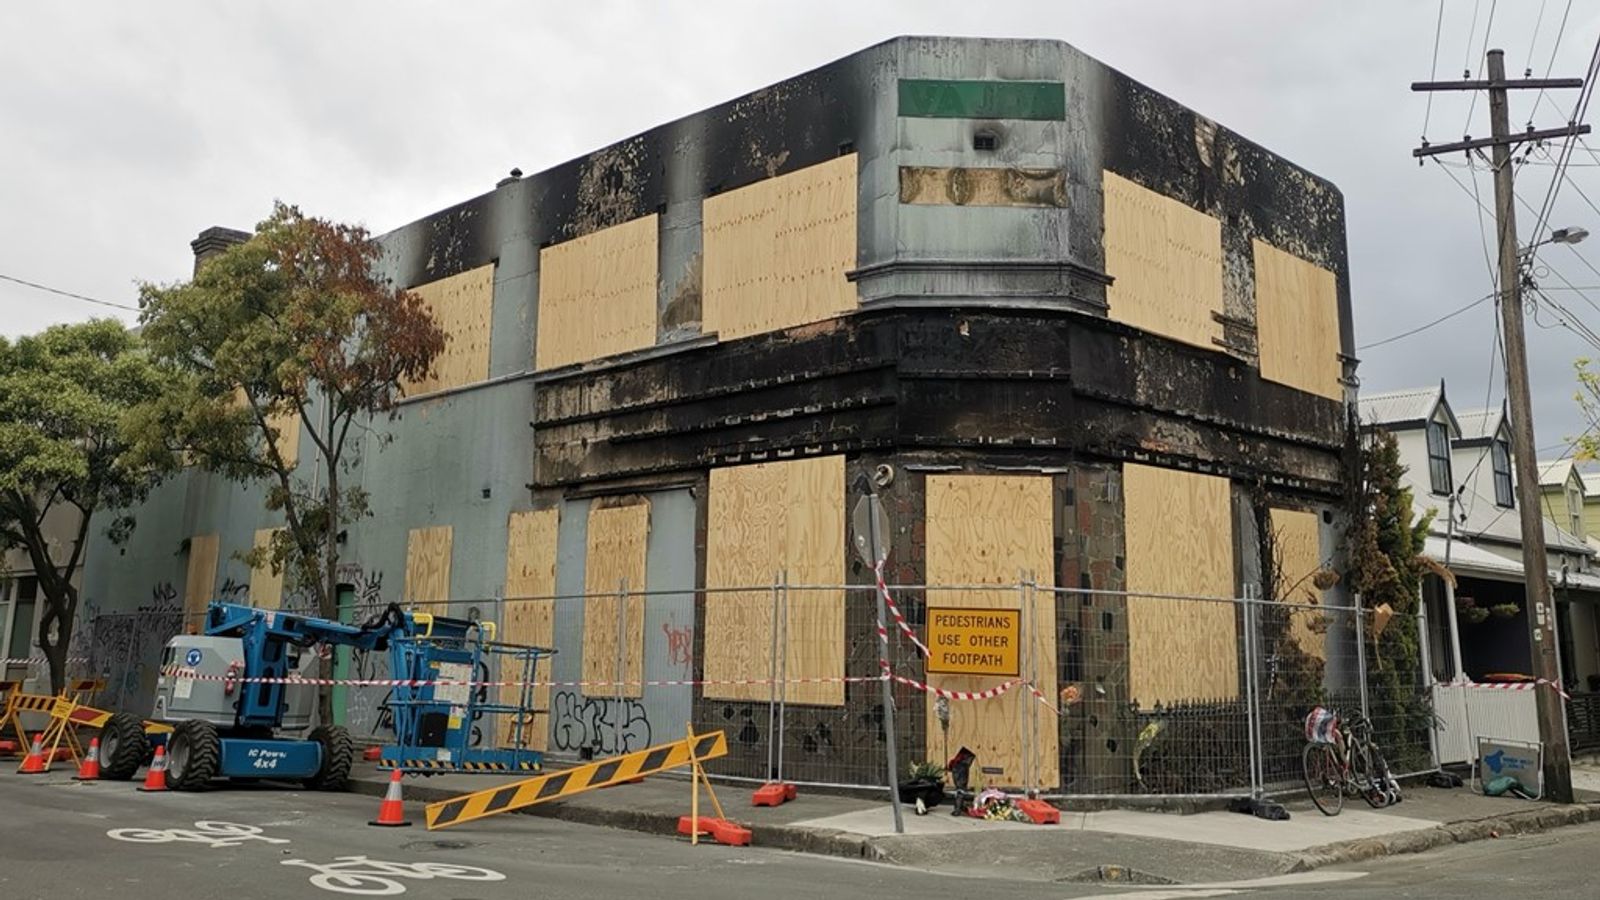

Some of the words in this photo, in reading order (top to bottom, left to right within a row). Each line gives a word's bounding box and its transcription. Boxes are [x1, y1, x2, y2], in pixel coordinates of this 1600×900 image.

[935, 615, 1011, 629] PEDESTRIANS
[937, 634, 961, 646] USE
[969, 635, 1008, 648] OTHER
[943, 652, 1004, 667] FOOTPATH
[253, 758, 277, 769] 4x4
